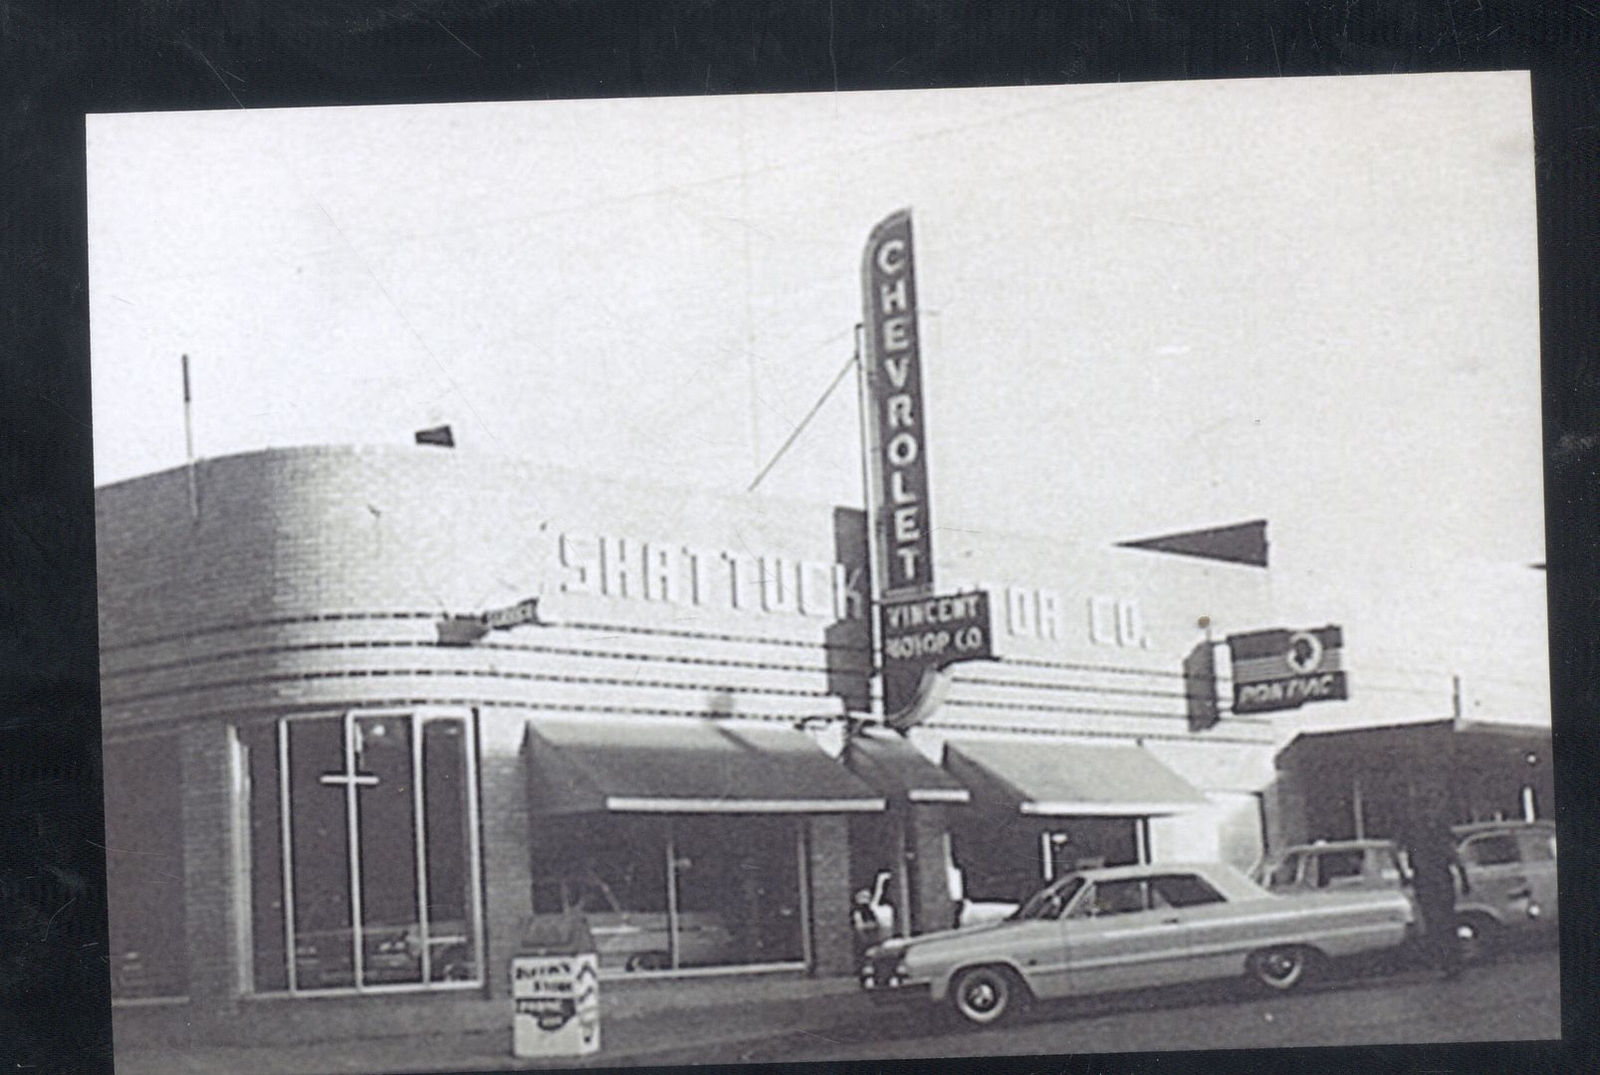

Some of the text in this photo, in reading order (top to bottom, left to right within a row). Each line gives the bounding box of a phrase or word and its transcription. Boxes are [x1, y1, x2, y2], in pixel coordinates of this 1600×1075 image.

[877, 240, 919, 579] CHEVROLET
[558, 533, 864, 620] SHATTUCK
[886, 595, 980, 628] VINCENT
[954, 625, 983, 651] CO
[1239, 674, 1334, 703] PONTIAC
